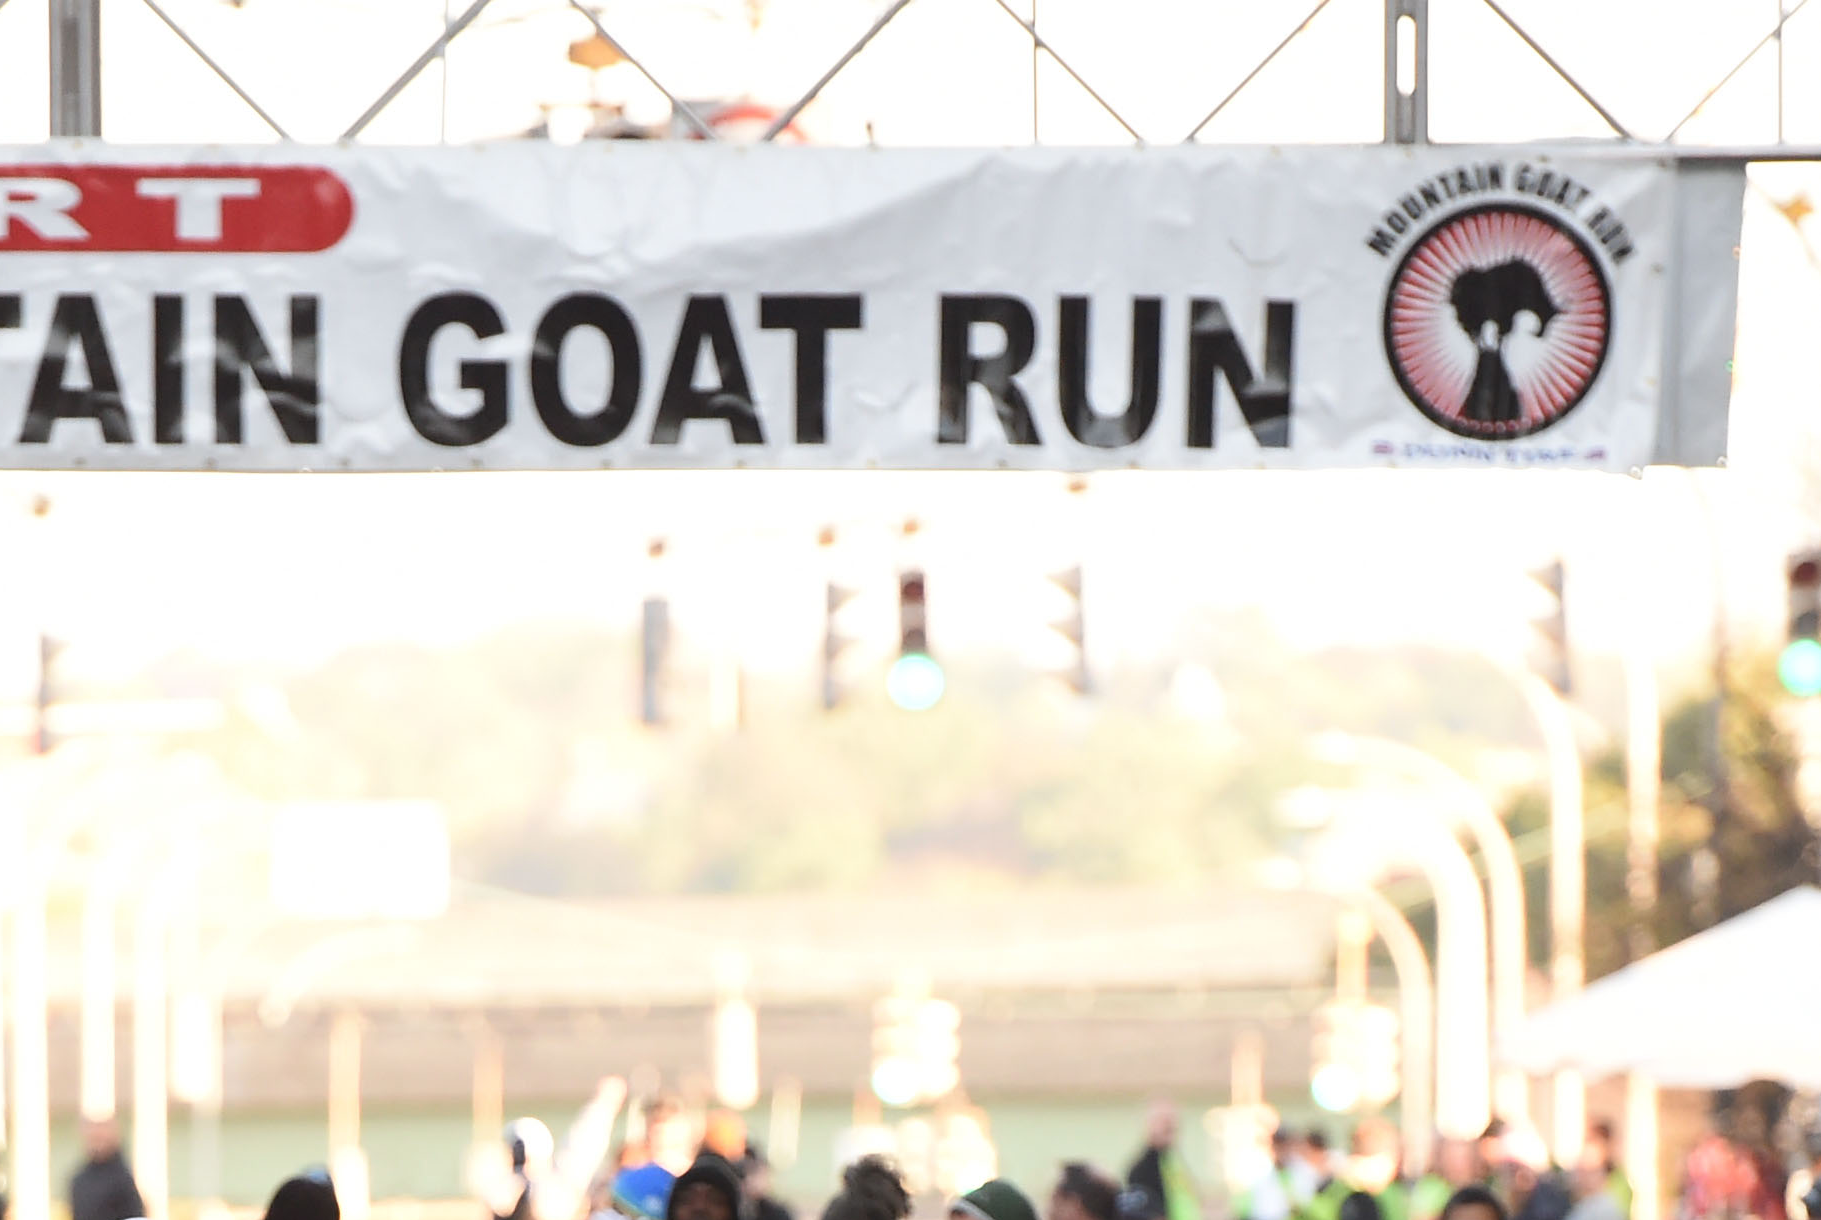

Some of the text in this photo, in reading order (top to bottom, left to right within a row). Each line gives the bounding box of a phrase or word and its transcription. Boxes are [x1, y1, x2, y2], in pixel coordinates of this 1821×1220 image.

[1367, 164, 1502, 257] MOUNTAIN
[1515, 164, 1590, 205] GOAT
[397, 290, 863, 448] GOAT
[935, 294, 1295, 450] RUN
